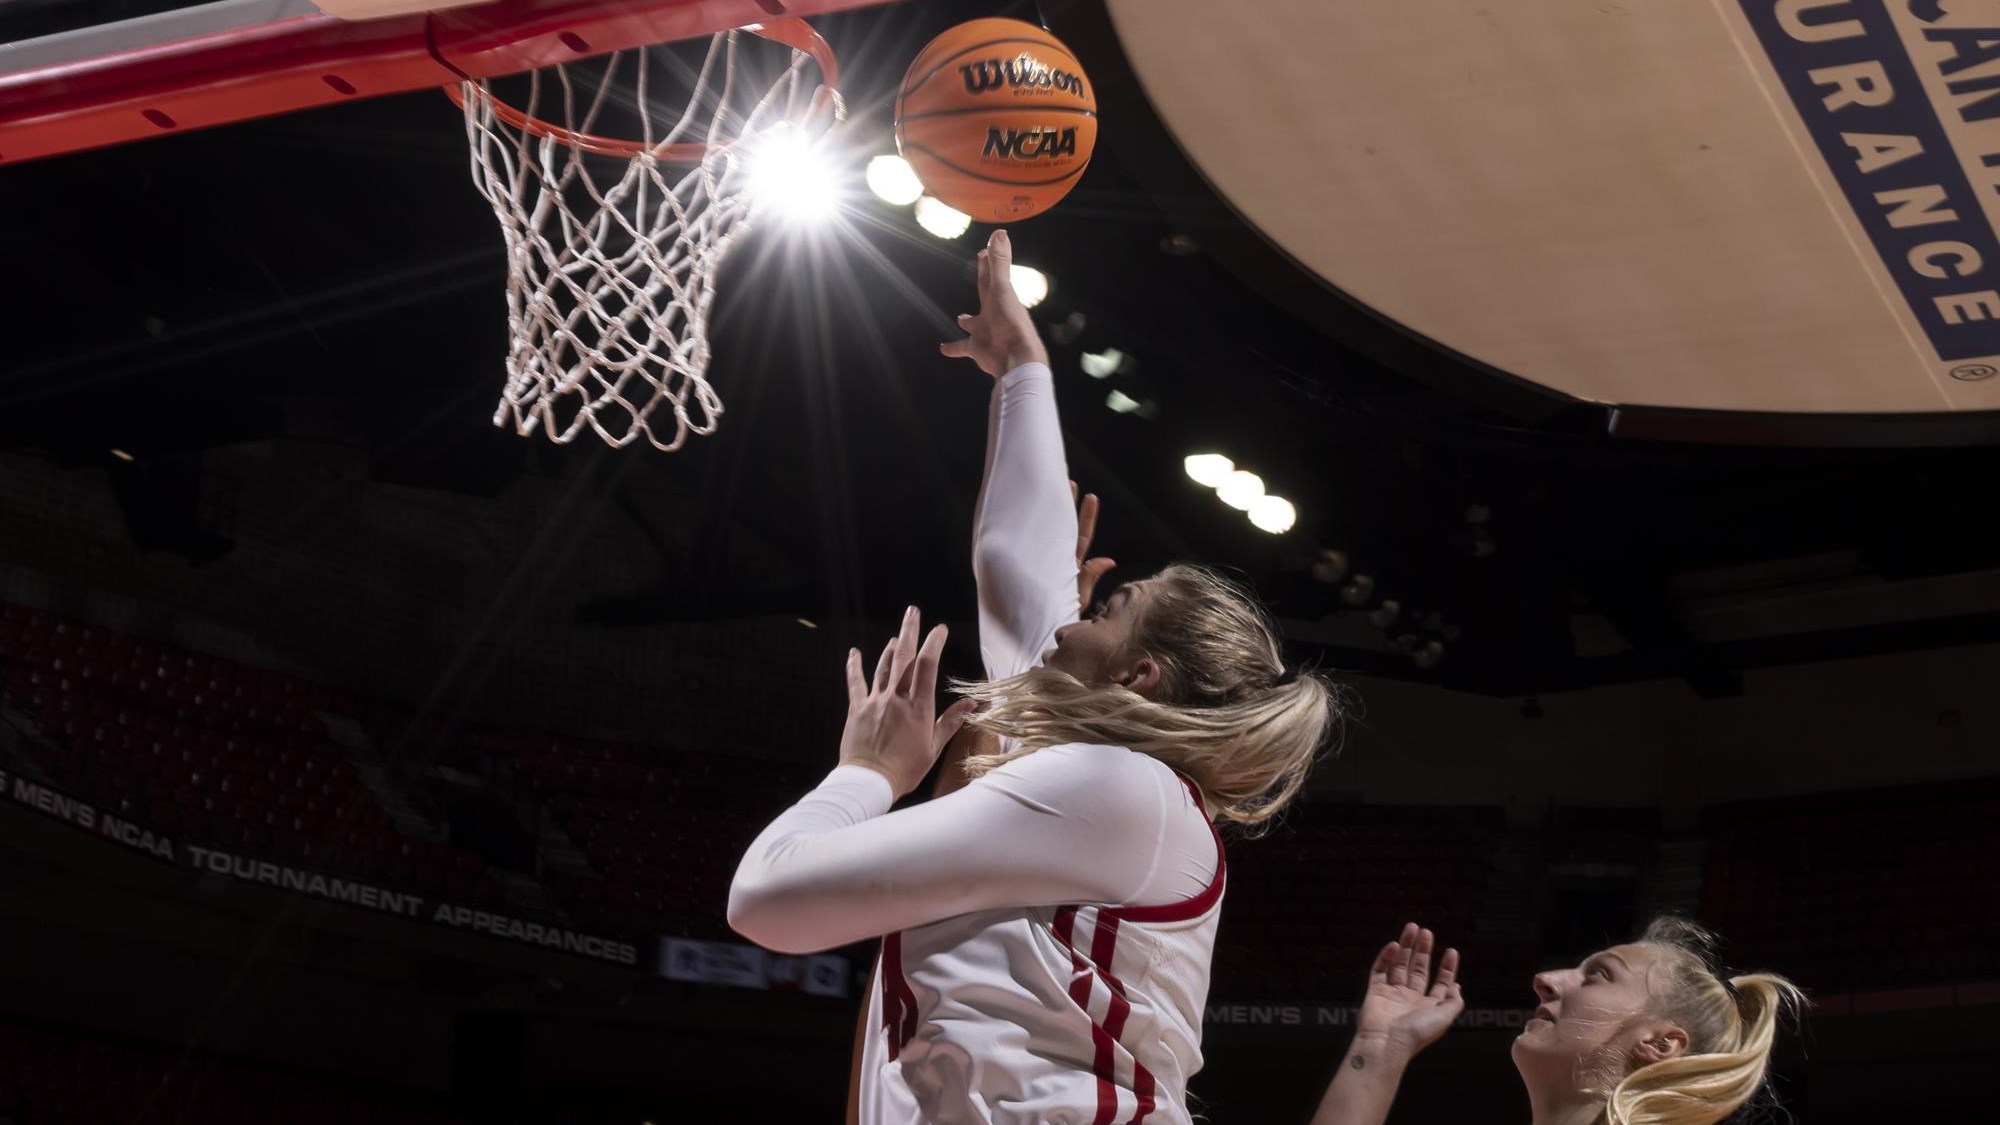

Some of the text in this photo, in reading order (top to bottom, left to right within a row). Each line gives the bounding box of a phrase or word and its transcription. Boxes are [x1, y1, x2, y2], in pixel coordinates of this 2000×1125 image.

[958, 56, 1086, 99] Wilson
[981, 126, 1076, 160] NCAA
[1774, 0, 2000, 325] URANCE
[13, 777, 97, 829] MEN'S
[101, 812, 177, 862] NCAA
[186, 845, 424, 917] TOURNAMENT
[433, 902, 638, 966] APPEARANCES
